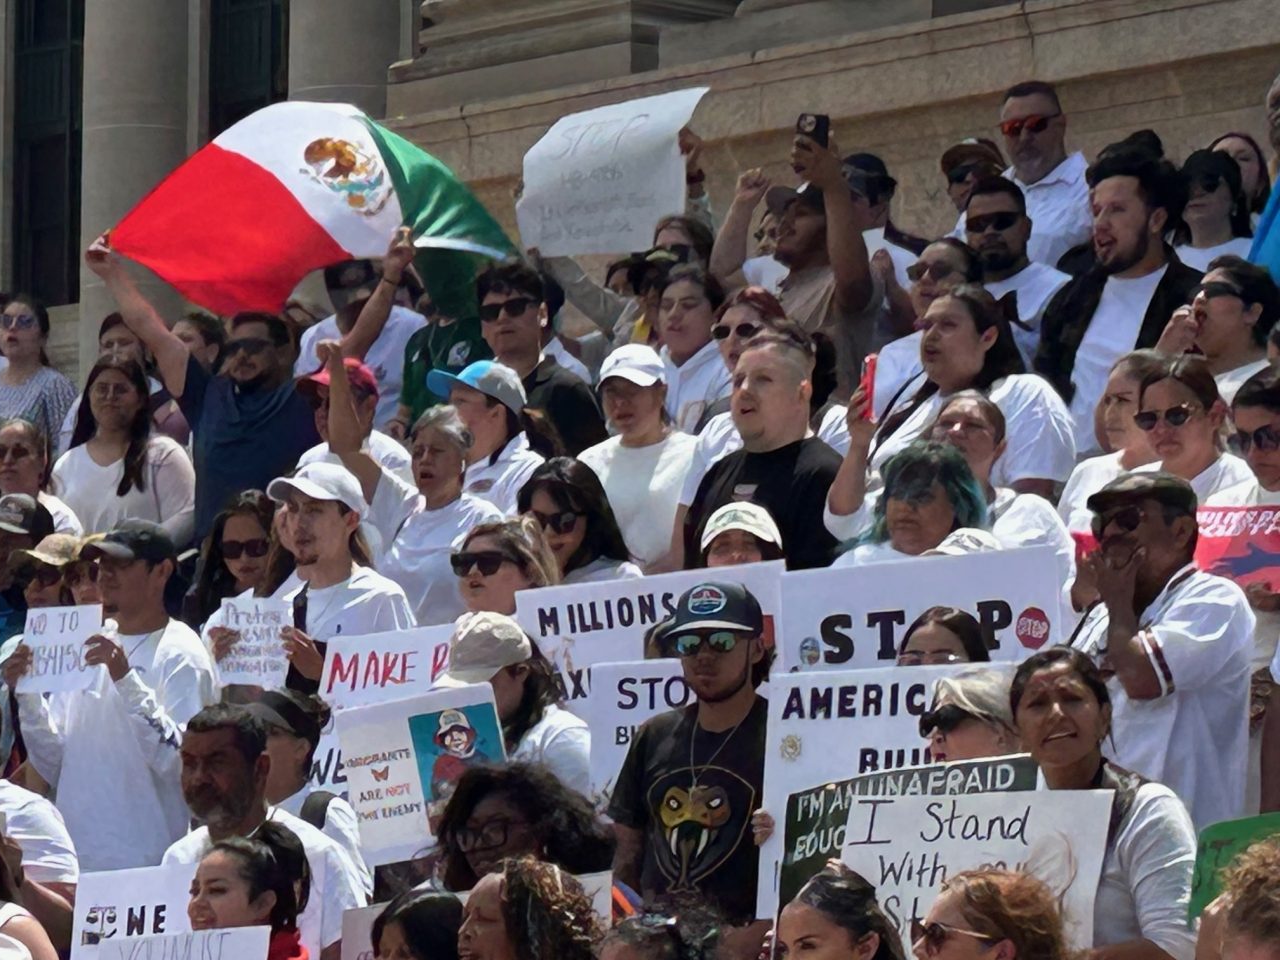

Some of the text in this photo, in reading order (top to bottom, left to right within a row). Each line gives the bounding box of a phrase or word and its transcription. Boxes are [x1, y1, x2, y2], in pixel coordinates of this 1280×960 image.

[538, 593, 677, 637] MILLIONS
[821, 600, 1013, 664] STP
[326, 651, 419, 694] MAKE
[782, 683, 937, 720] AMERIC
[919, 800, 1031, 847] Stand
[878, 850, 948, 889] With
[126, 904, 166, 937] WE
